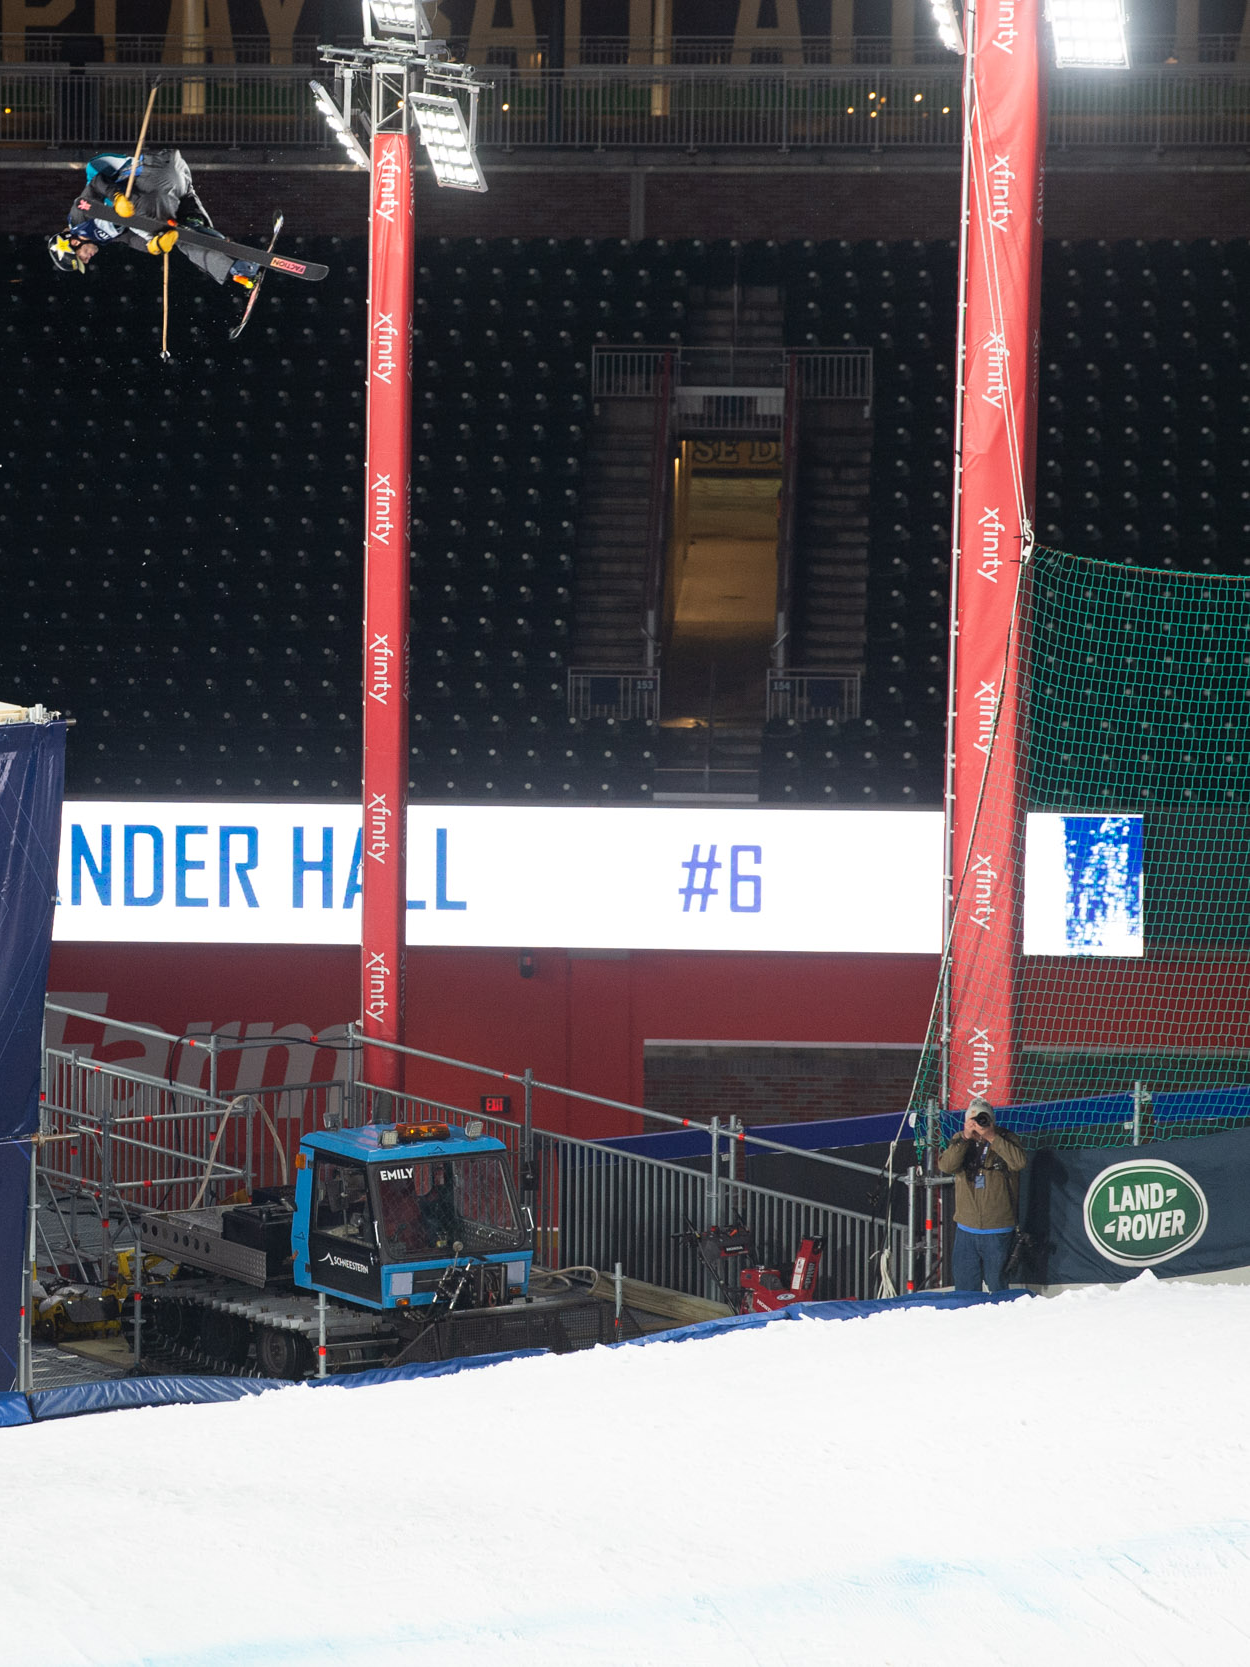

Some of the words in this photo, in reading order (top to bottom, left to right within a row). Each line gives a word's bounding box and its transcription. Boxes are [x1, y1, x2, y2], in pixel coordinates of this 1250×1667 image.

[992, 0, 1018, 54] inity
[376, 149, 401, 223] xfinity
[987, 155, 1015, 232] xfinity
[373, 312, 398, 384] xfinity
[982, 331, 1010, 408] xfinity
[370, 473, 396, 545] xfinity
[977, 506, 1005, 583] xfinity
[369, 633, 393, 705] xfinity
[367, 792, 392, 864] xfinity
[56, 823, 260, 908] NDER
[292, 826, 467, 910] HL
[678, 844, 762, 913] #6
[970, 854, 997, 930] xfinity
[365, 952, 390, 1023] xfinity
[967, 1027, 995, 1101] xfinity
[380, 1168, 414, 1181] EMILY
[1108, 1182, 1165, 1212] LAND
[1116, 1209, 1186, 1241] ROVER
[333, 1256, 369, 1274] SCHNEESTERN
[756, 1298, 773, 1312] HOND
